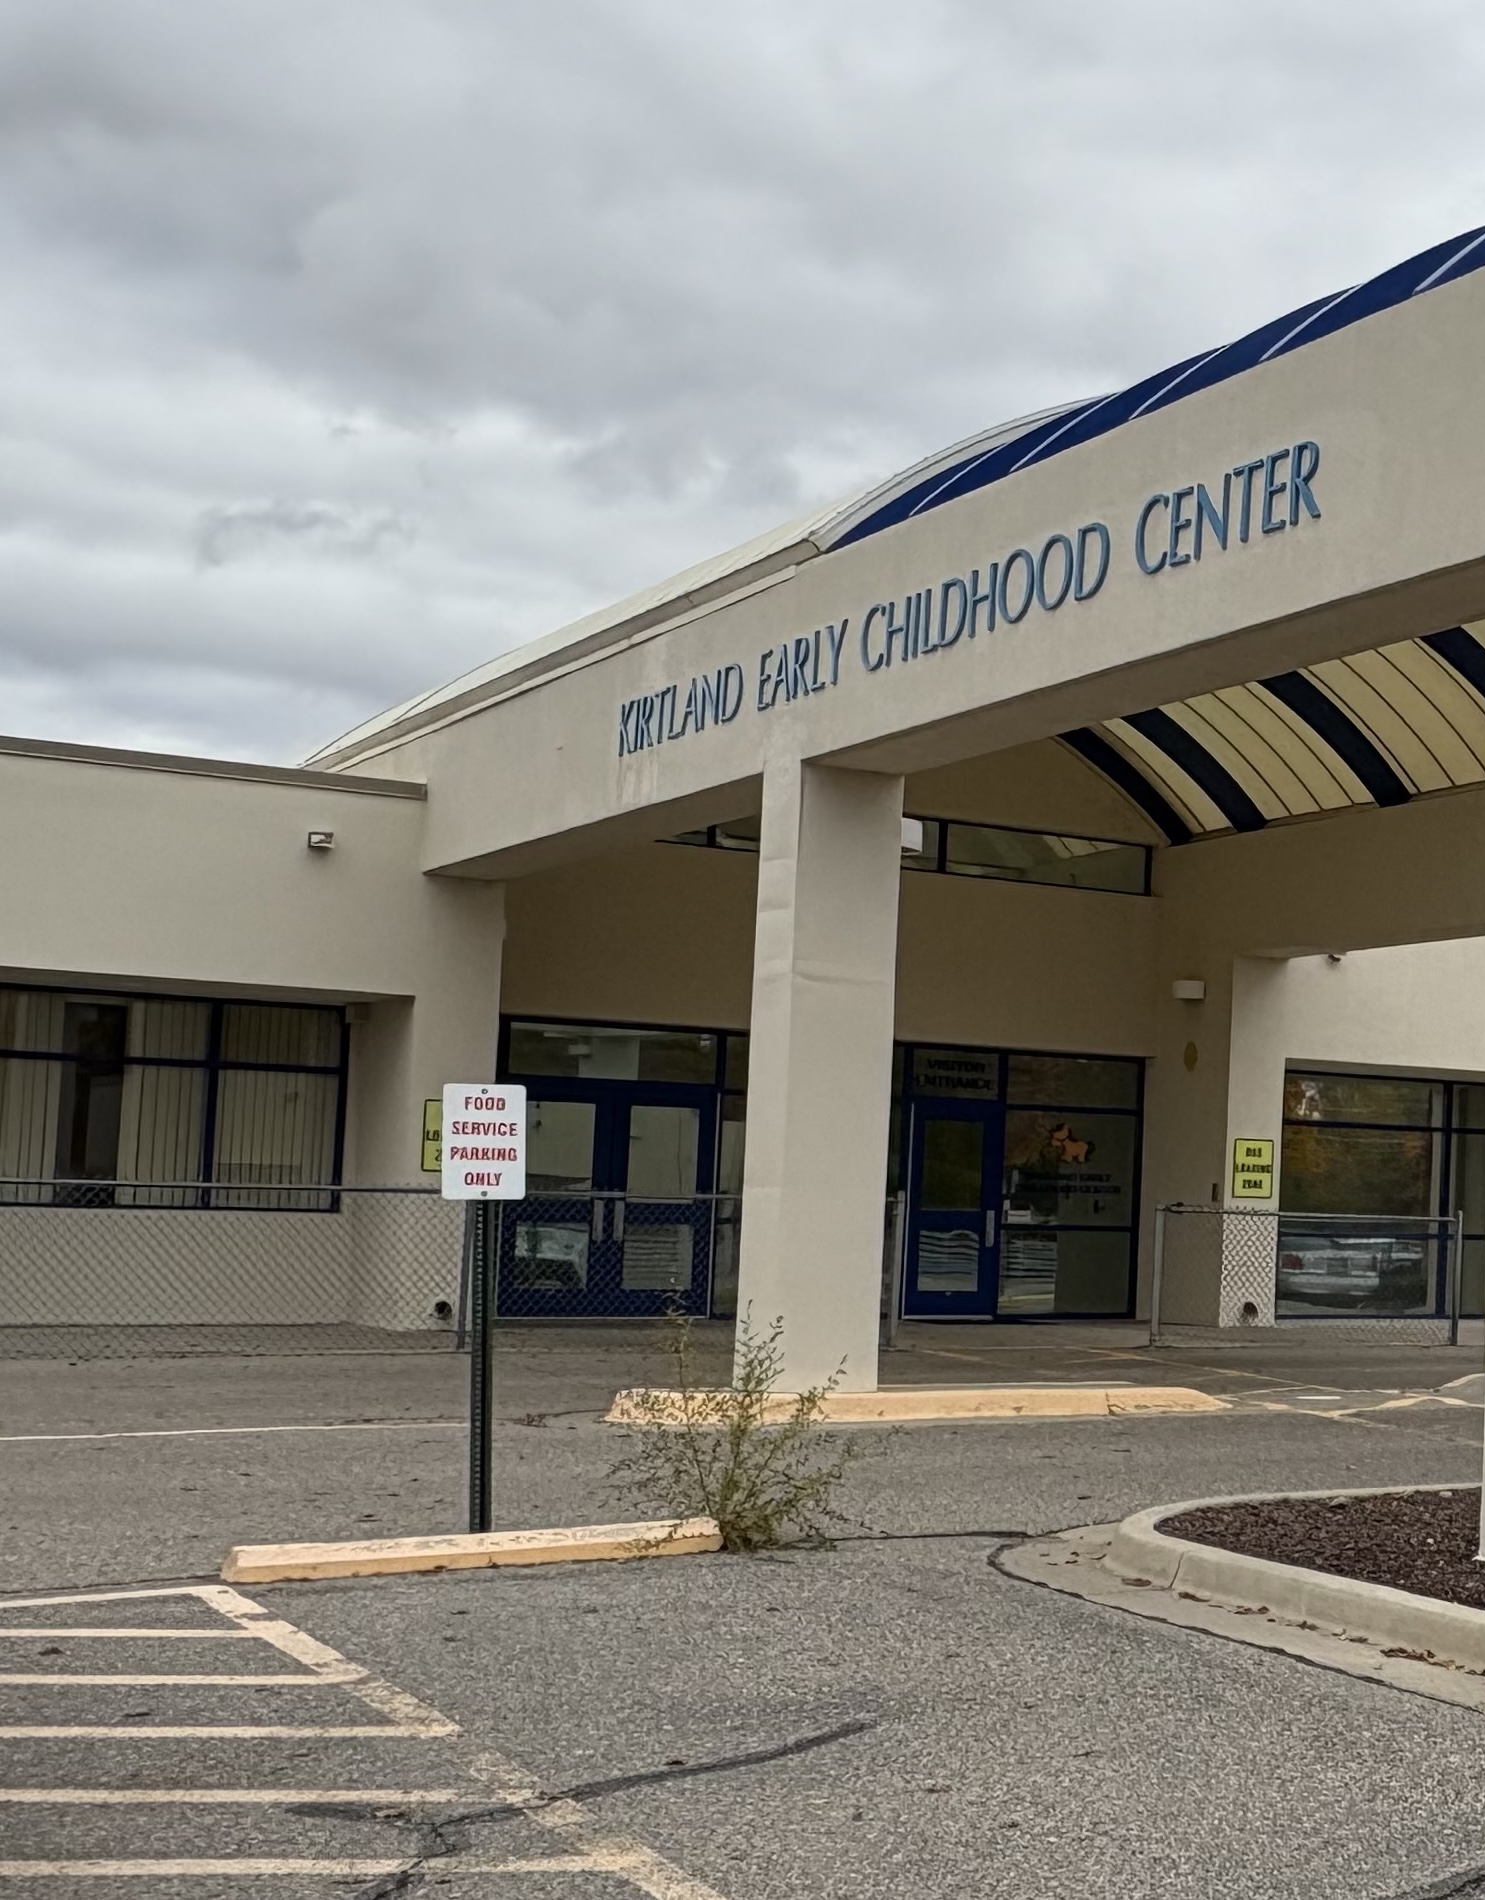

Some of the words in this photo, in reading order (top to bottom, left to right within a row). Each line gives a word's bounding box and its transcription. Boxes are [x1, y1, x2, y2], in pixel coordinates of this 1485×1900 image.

[618, 662, 744, 758] KIRTLAND
[757, 618, 849, 712] EARLY
[859, 520, 1112, 673] CHILDHOOD
[1133, 440, 1323, 576] CENTER
[464, 1096, 506, 1111] FOOD
[451, 1121, 518, 1137] SERVICE
[450, 1146, 518, 1162] PARKING
[464, 1172, 502, 1187] ONLY
